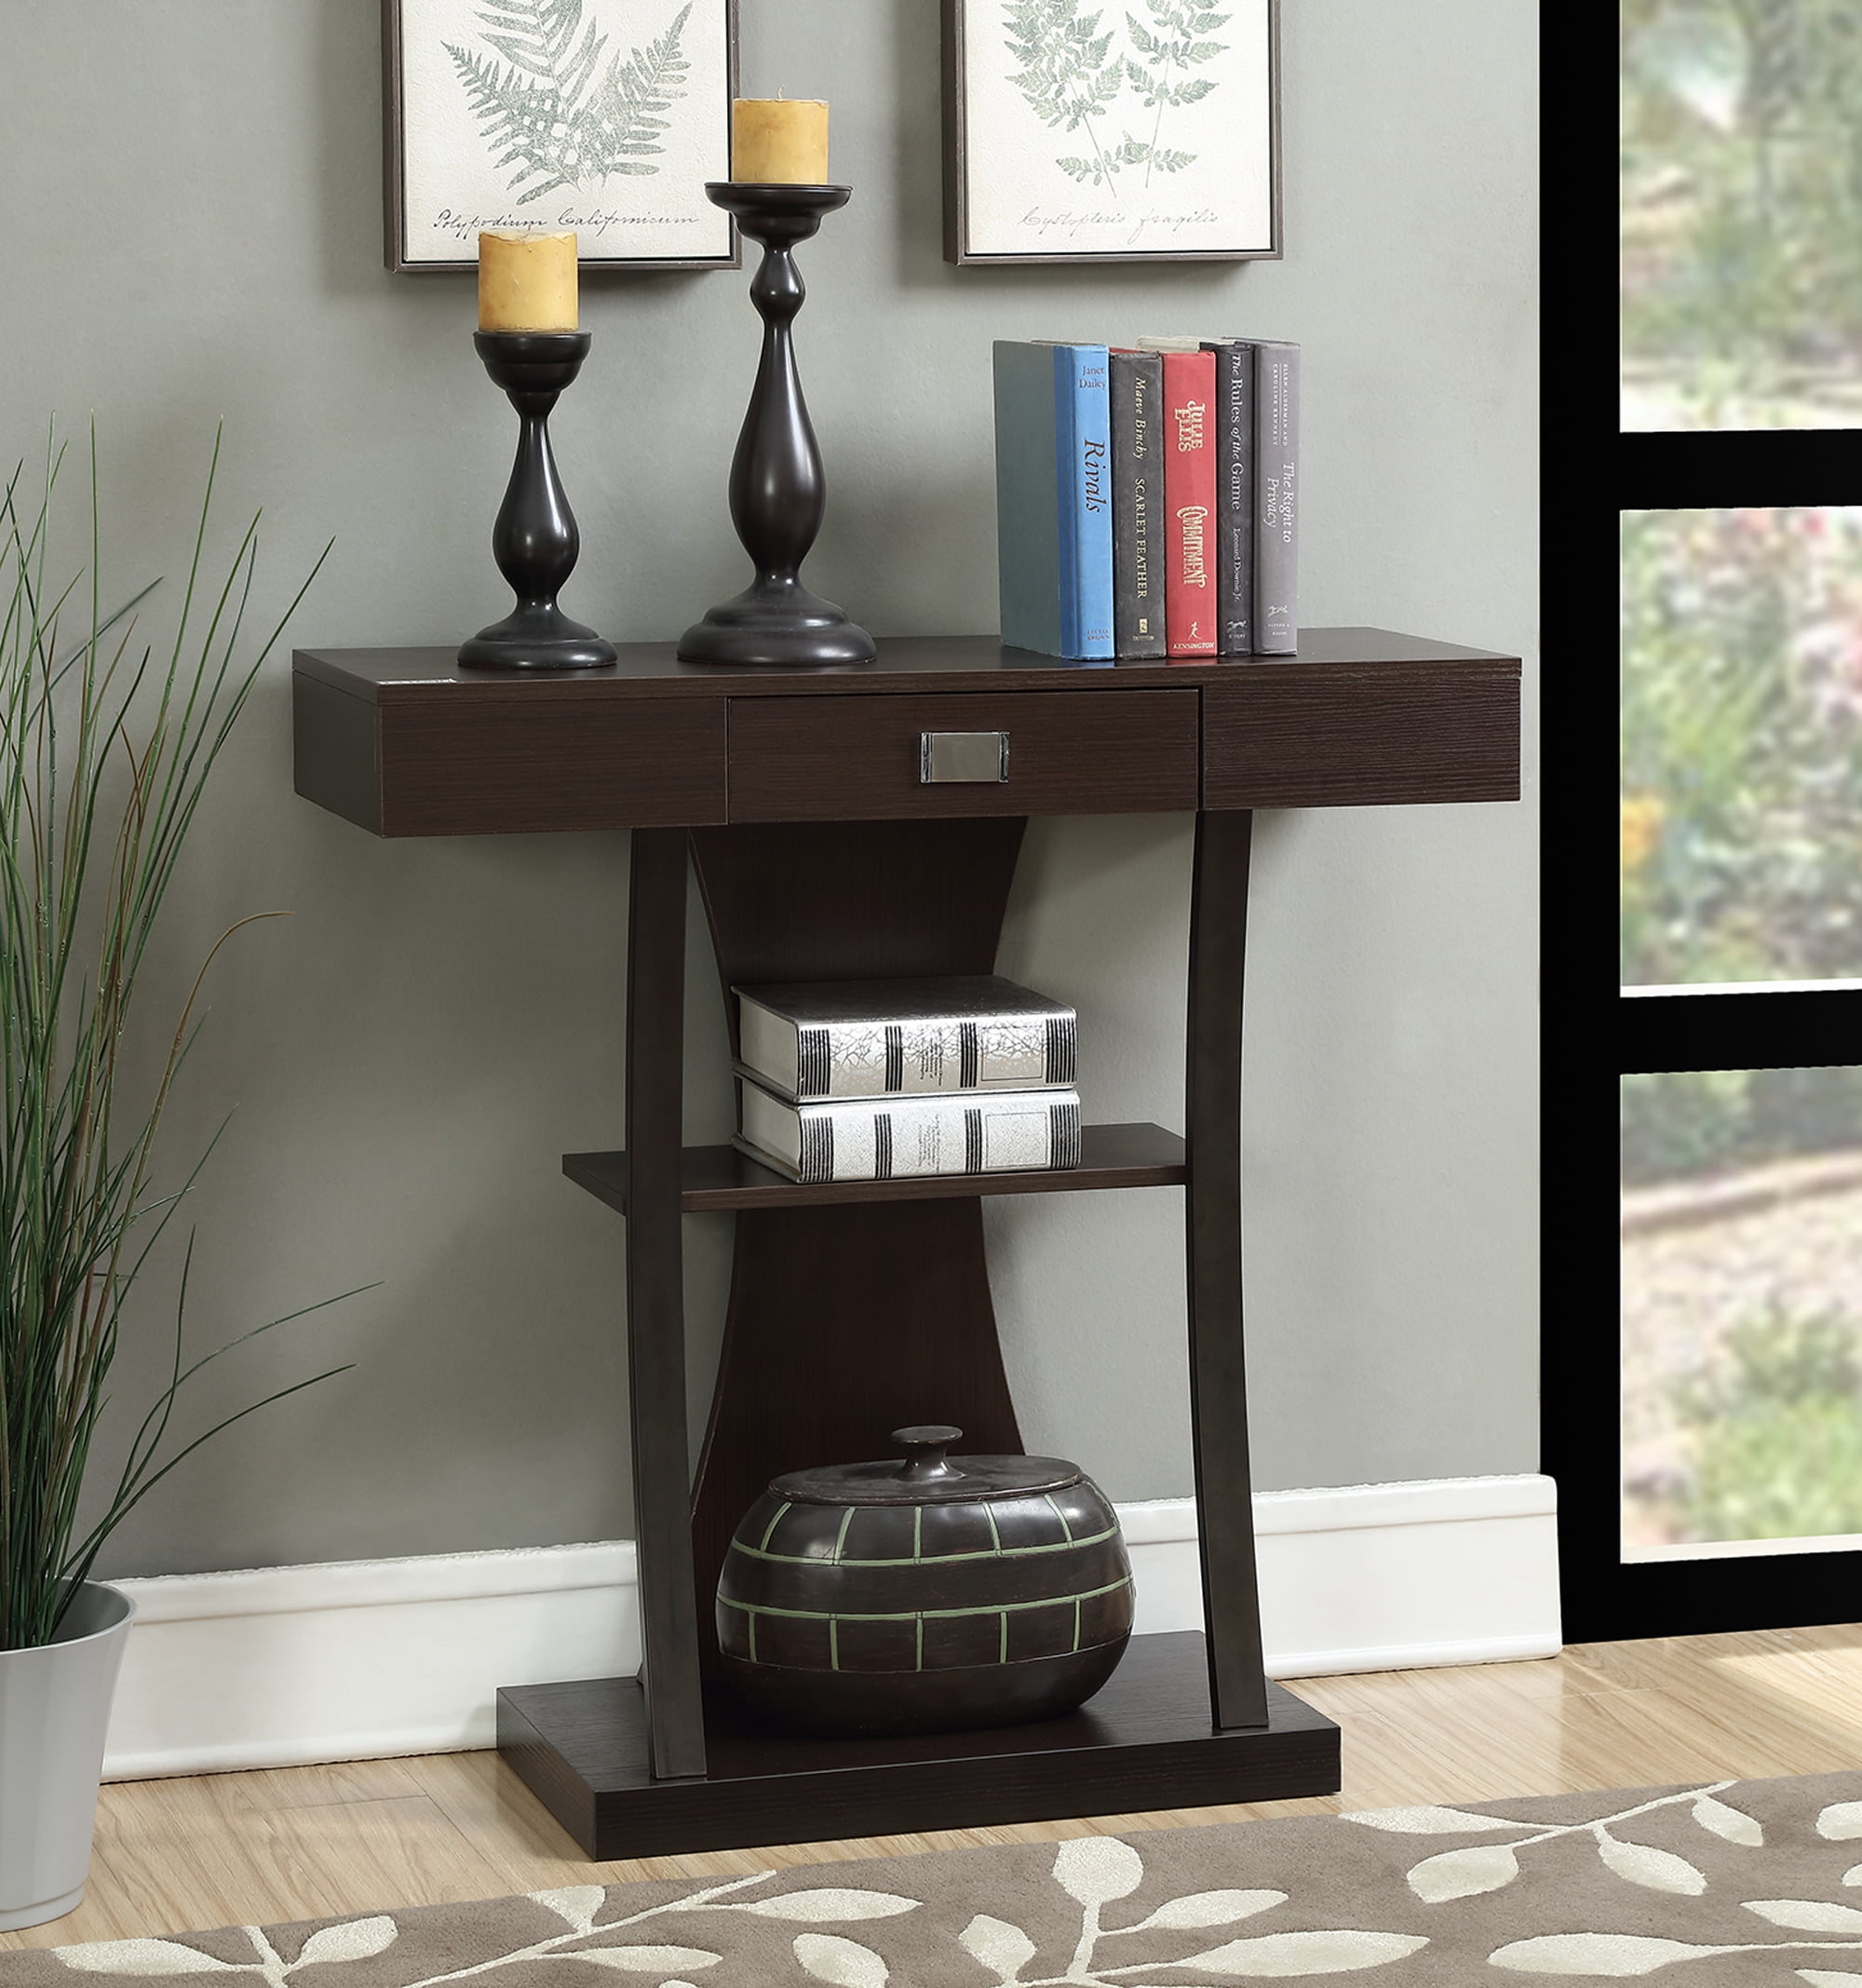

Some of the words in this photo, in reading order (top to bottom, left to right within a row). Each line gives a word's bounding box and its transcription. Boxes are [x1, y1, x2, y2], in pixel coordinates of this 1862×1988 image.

[433, 209, 547, 239] Polypodium
[1127, 208, 1219, 244] fragilis
[1079, 378, 1107, 390] Dailey
[1082, 366, 1104, 376] Janet
[1232, 355, 1241, 376] The
[1135, 376, 1147, 414] Maeve
[1231, 378, 1243, 424] Rules
[1133, 419, 1147, 459] Binchy
[1175, 408, 1193, 453] ELLIS
[1187, 400, 1206, 449] JULIE
[1230, 426, 1242, 441] of
[1232, 441, 1242, 460] the
[1085, 438, 1107, 513] Rivals
[1232, 463, 1244, 510] Game
[1283, 463, 1295, 488] The
[1135, 478, 1146, 535] SCARLET
[1263, 477, 1279, 528] Privacy
[1279, 491, 1295, 530] Right
[1176, 506, 1208, 588] COMMITMENT
[1283, 530, 1294, 543] to
[1137, 539, 1148, 599] FEATHER
[1173, 642, 1215, 650] KENSINGTON
